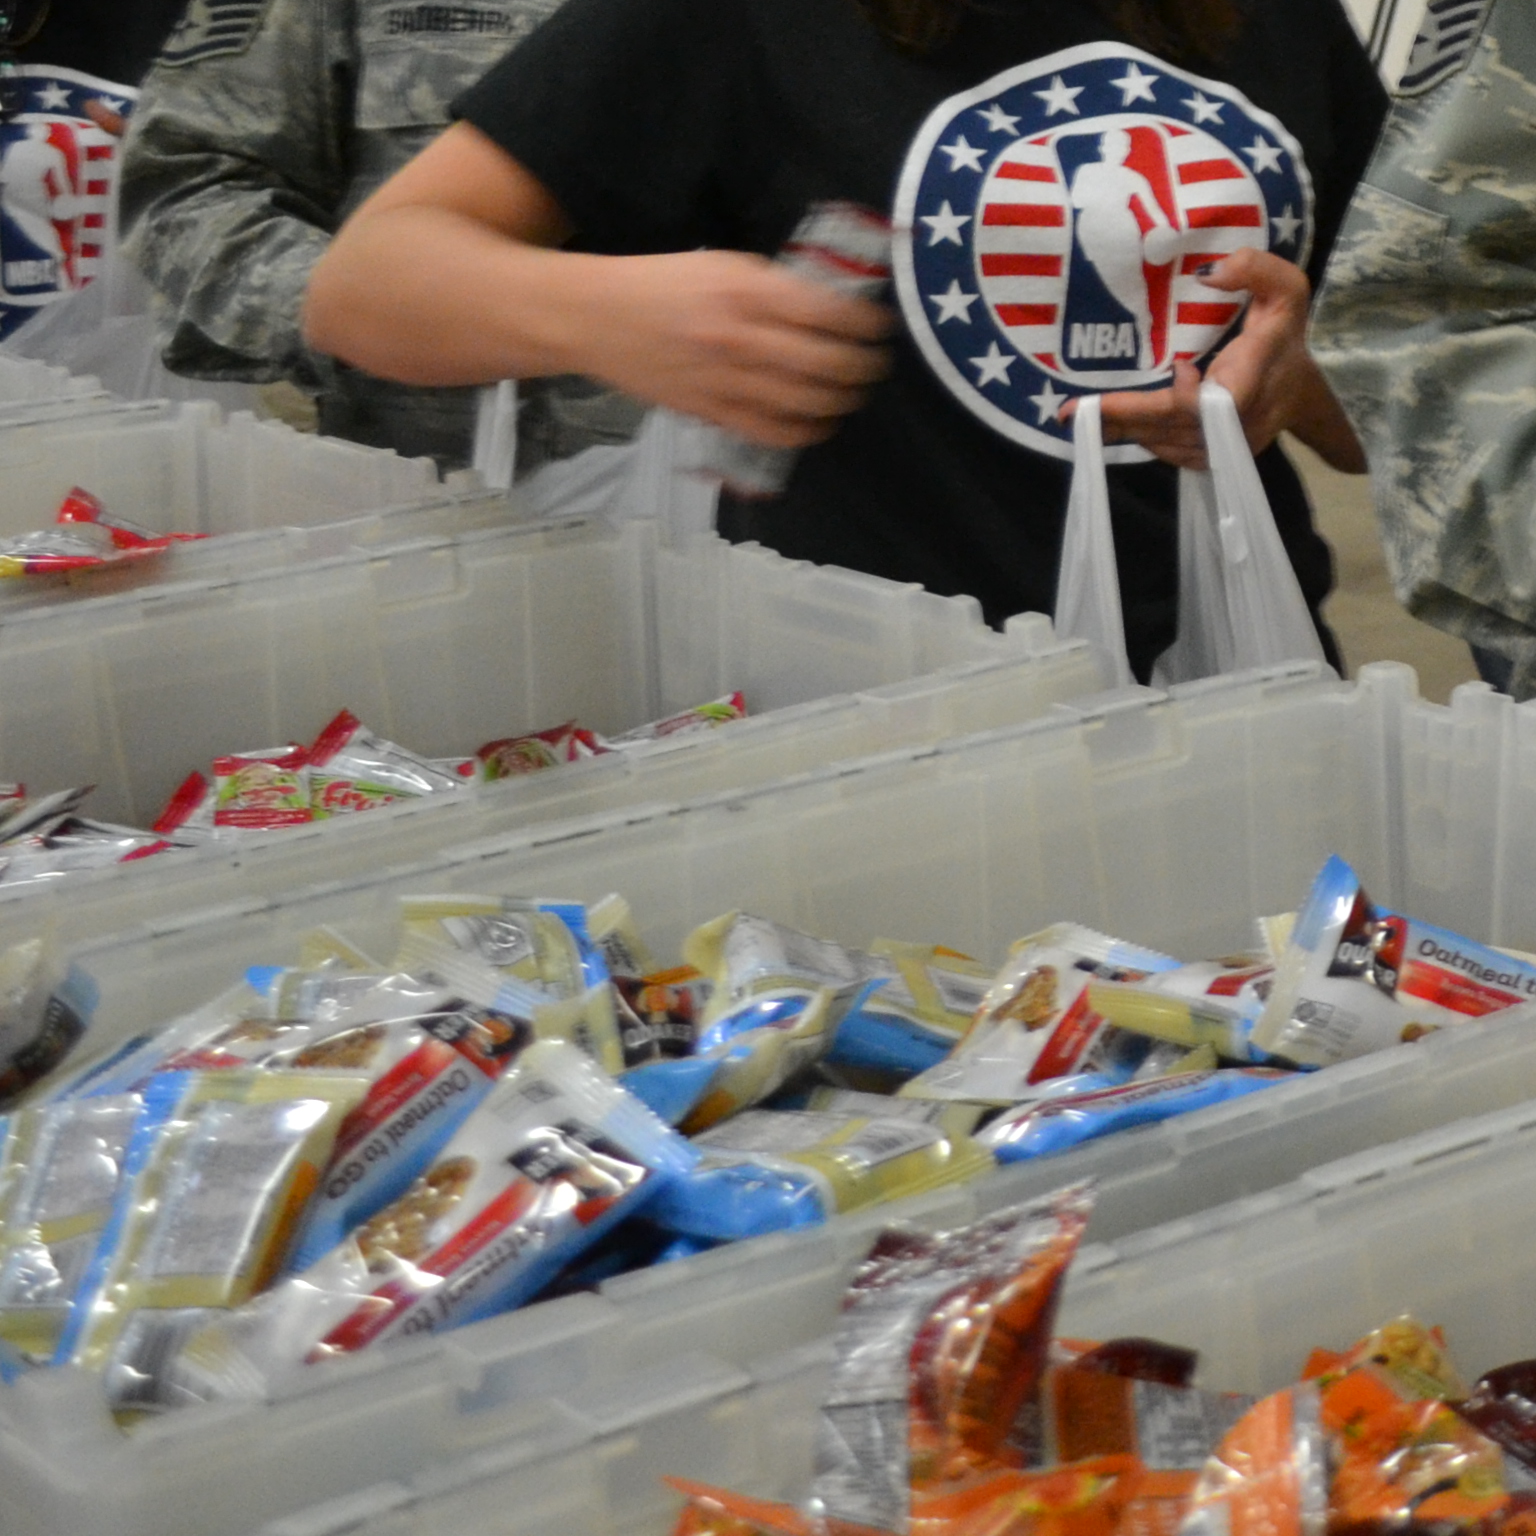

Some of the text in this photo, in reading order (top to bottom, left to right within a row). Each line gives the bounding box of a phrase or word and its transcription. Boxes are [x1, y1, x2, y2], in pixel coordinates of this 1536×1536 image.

[1068, 322, 1137, 359] NBA
[1418, 938, 1519, 989] Oatmeal
[384, 1068, 471, 1148] Oatmeal
[363, 1138, 390, 1162] to
[326, 1161, 365, 1200] GO
